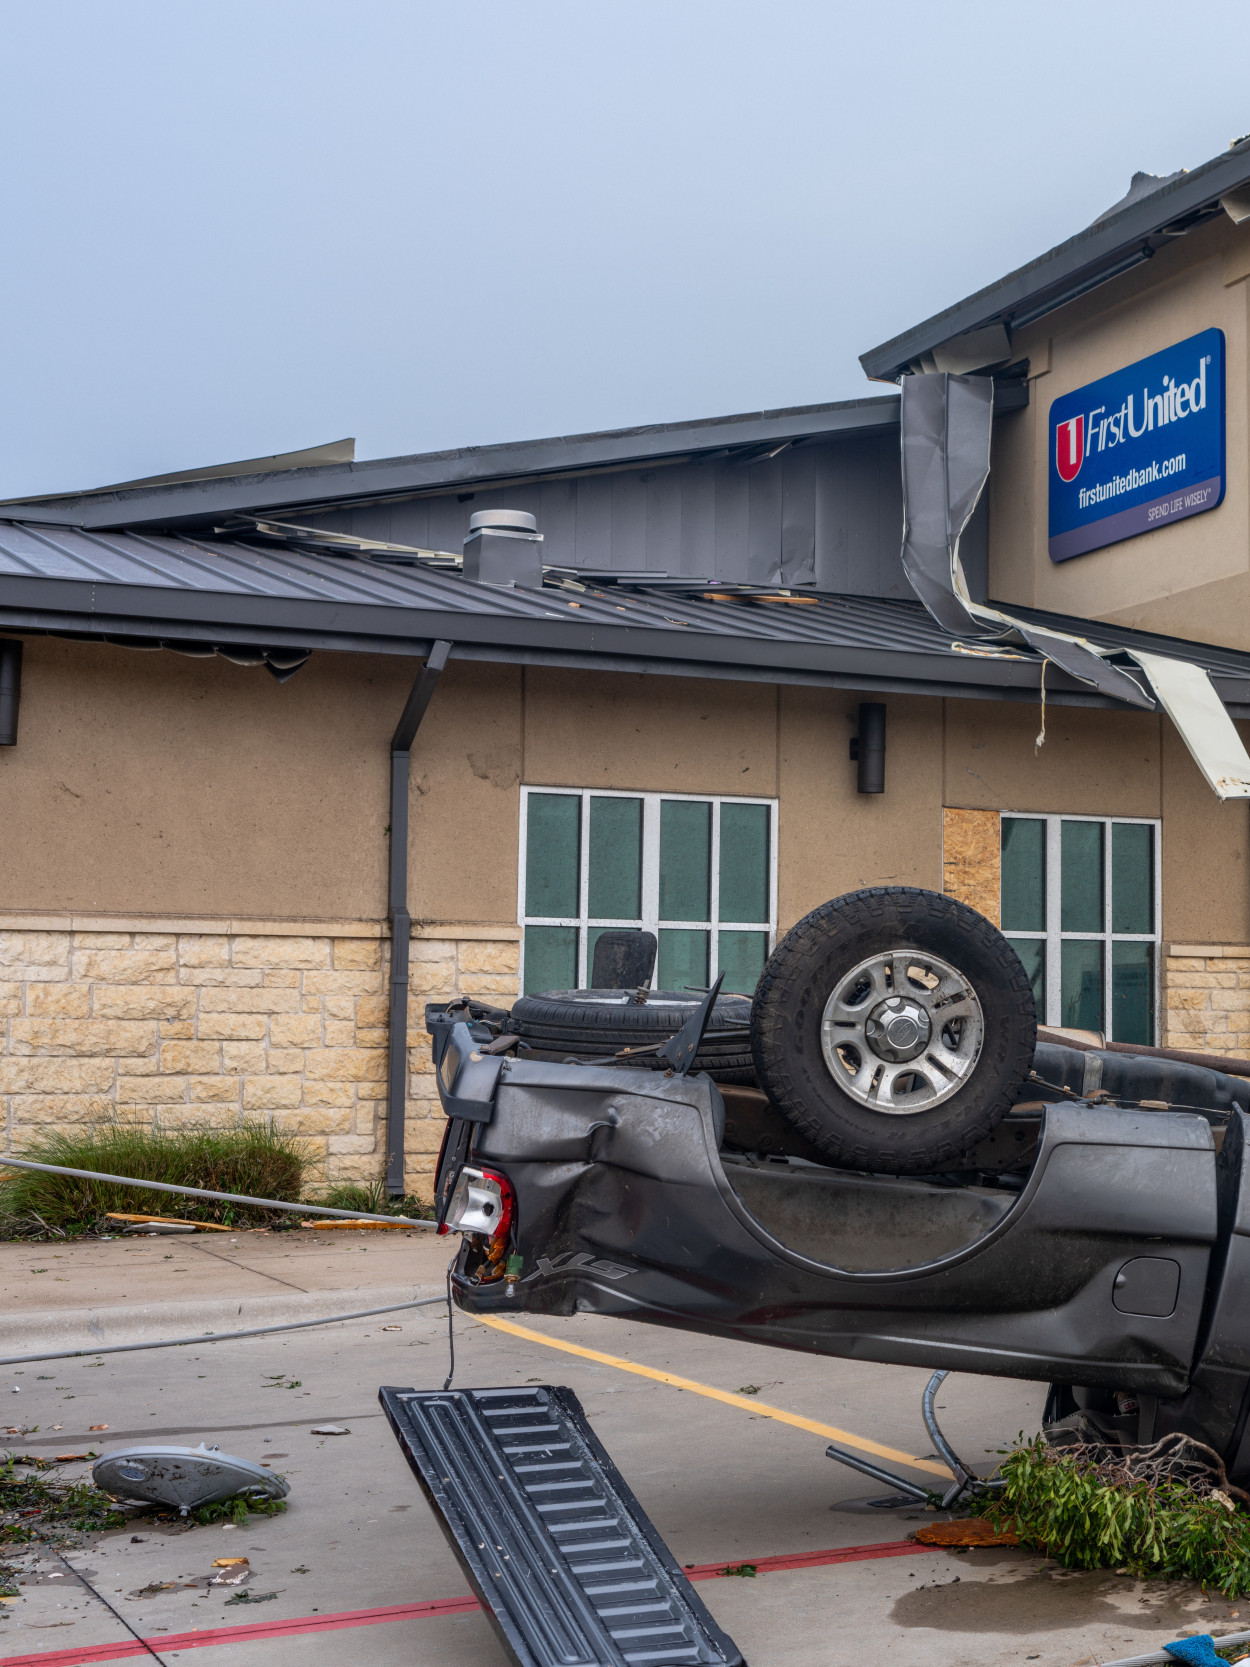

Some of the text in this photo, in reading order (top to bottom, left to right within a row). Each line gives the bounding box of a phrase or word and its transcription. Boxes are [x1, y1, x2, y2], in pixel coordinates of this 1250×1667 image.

[1079, 453, 1186, 509] firstunitedbank.com
[1148, 503, 1170, 521] SPEND
[1170, 497, 1183, 513] LIFE
